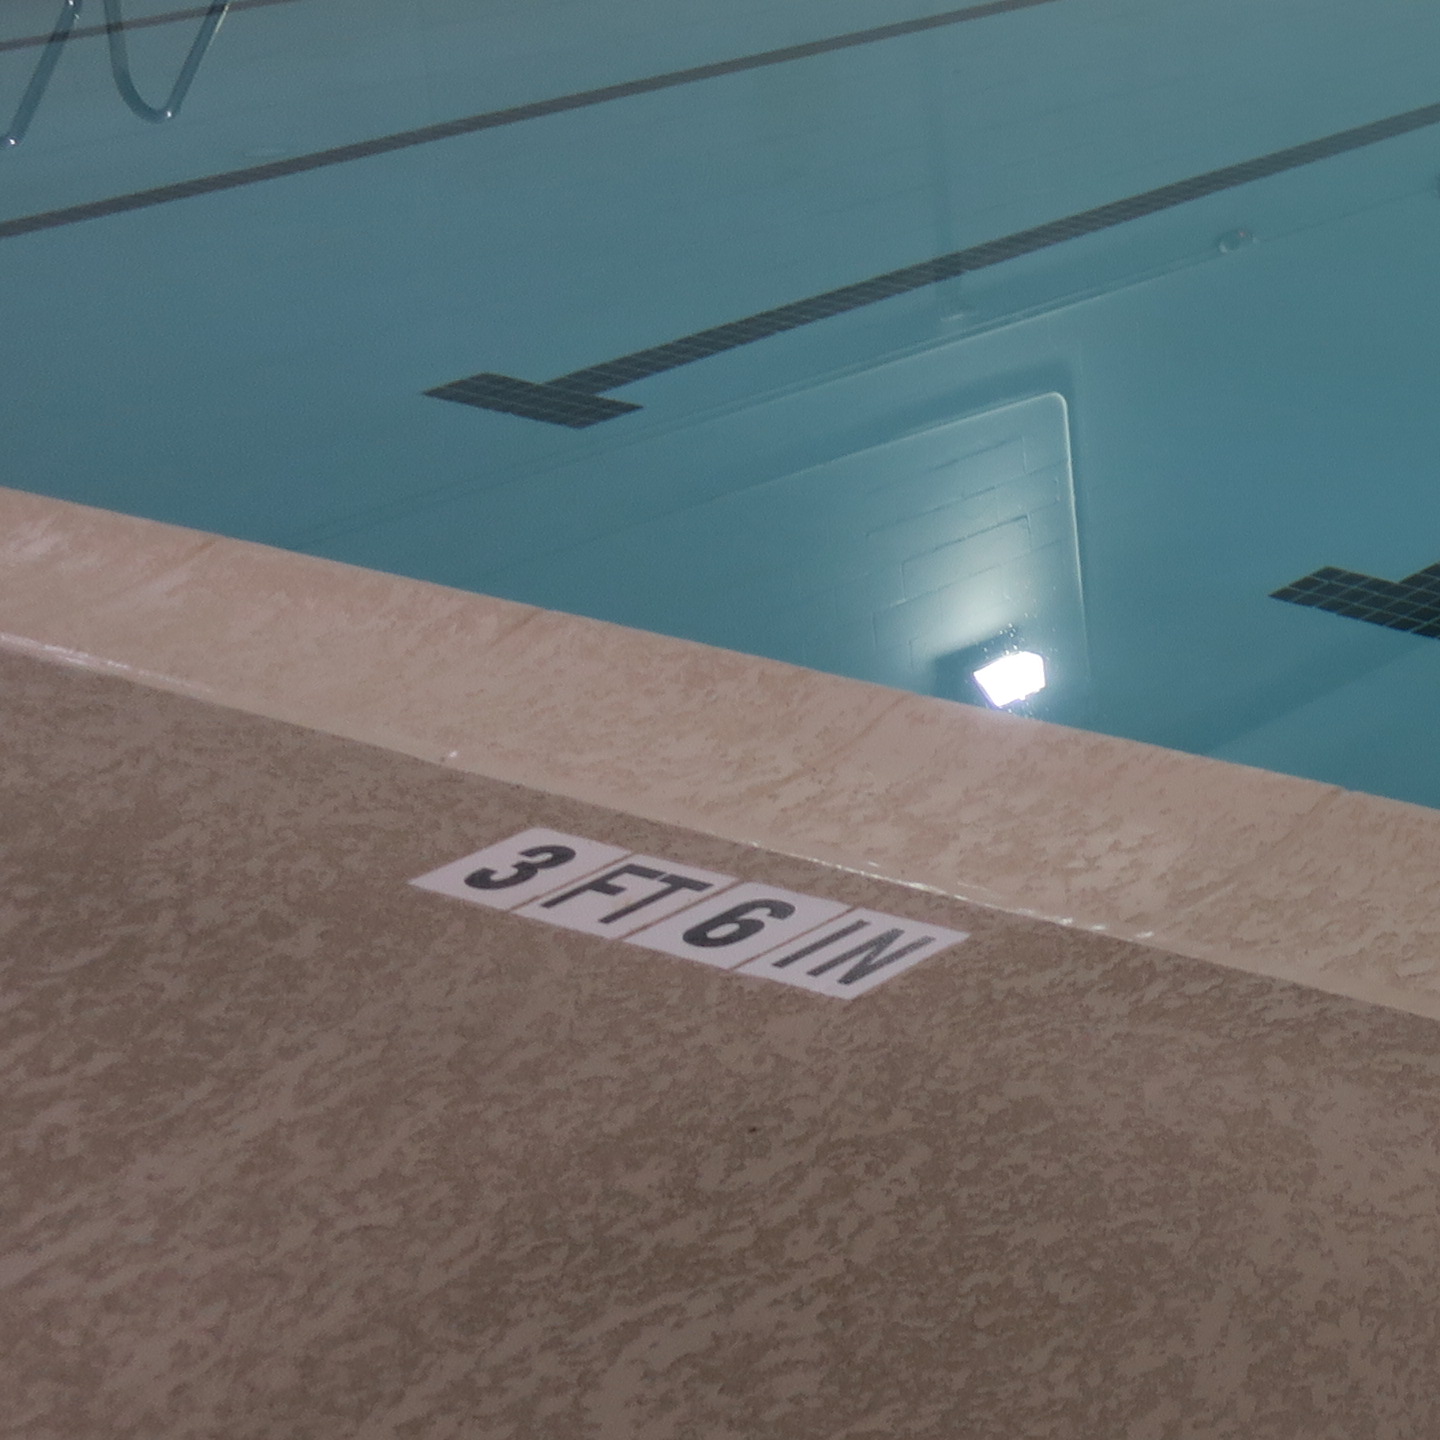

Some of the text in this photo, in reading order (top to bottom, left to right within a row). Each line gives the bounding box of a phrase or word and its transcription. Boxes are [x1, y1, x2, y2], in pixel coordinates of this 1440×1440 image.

[464, 845, 936, 985] 3 FT 6 IN
